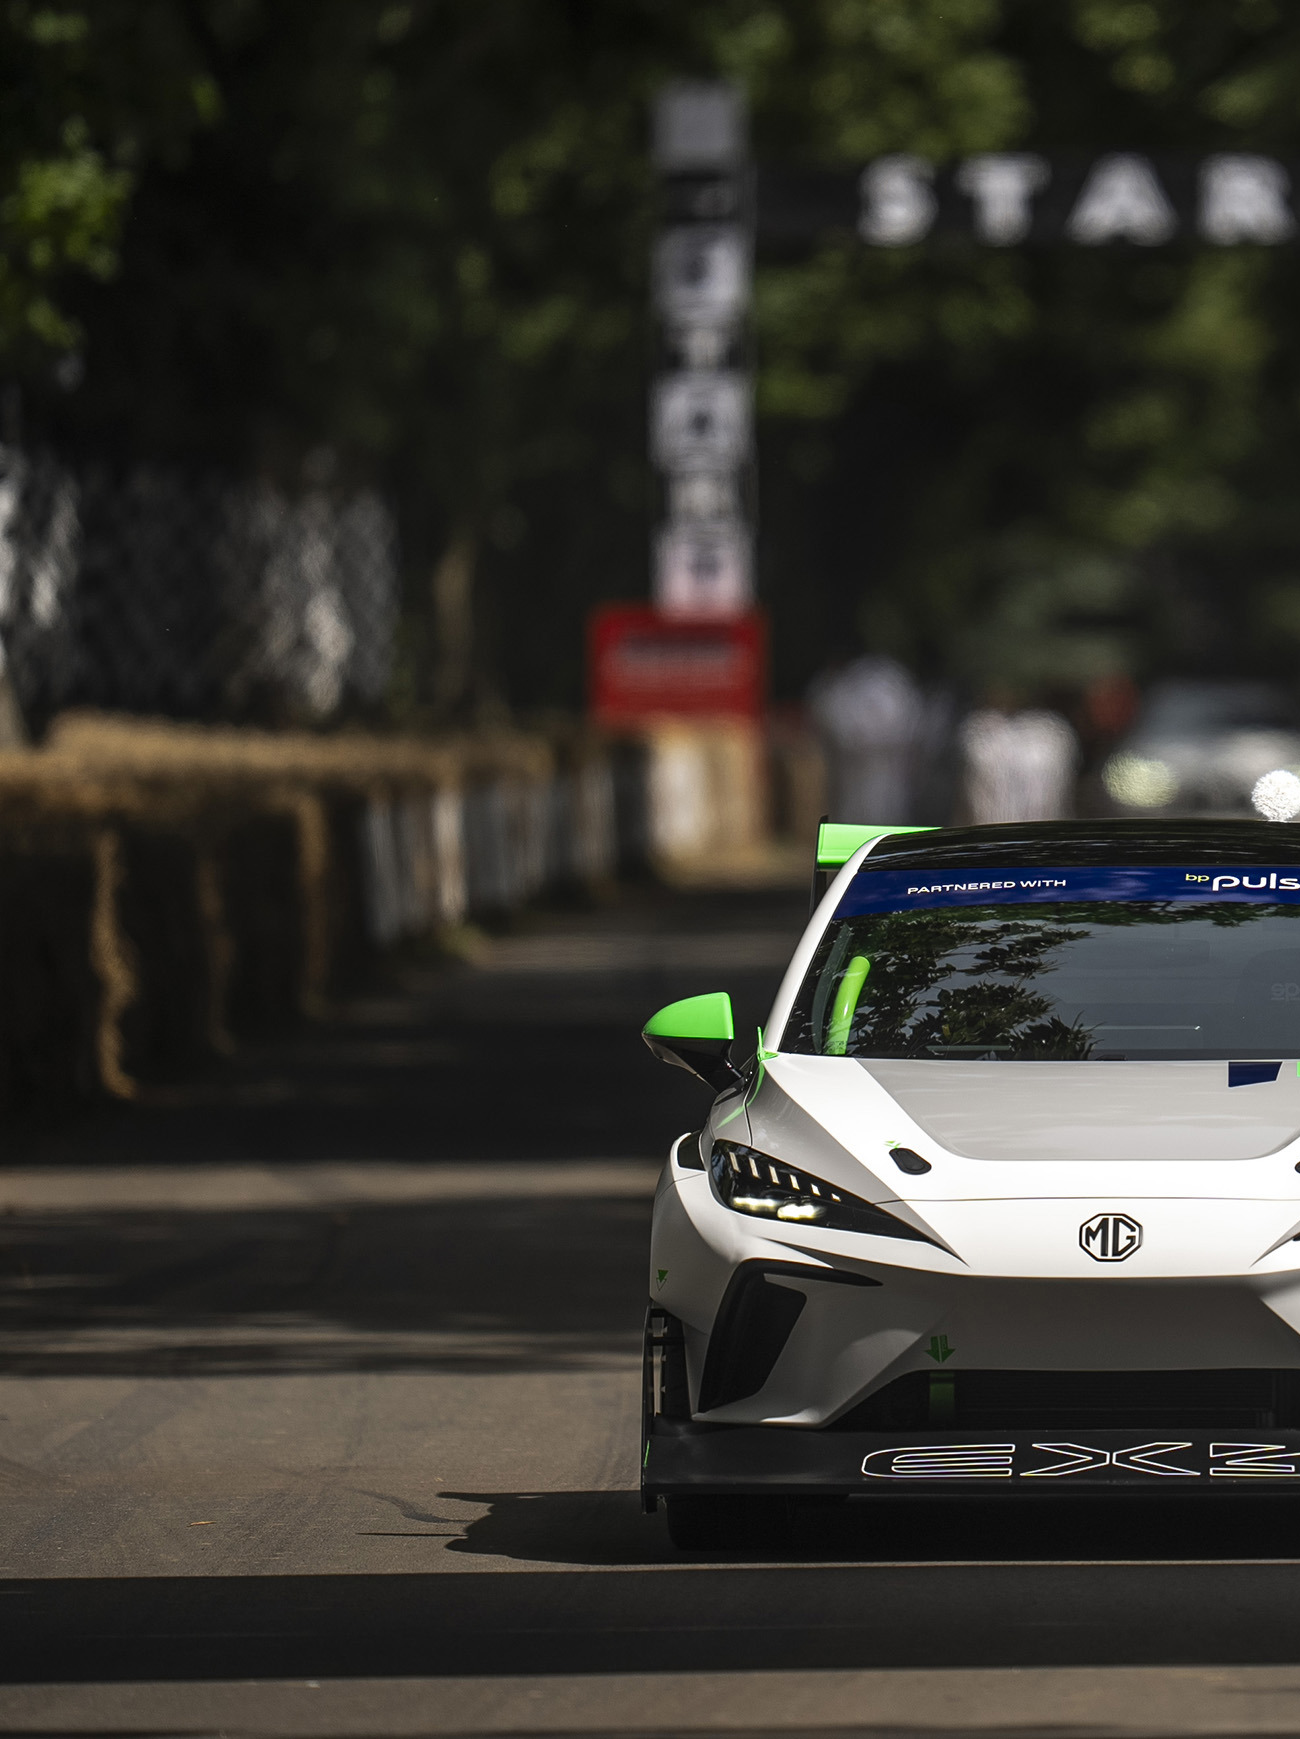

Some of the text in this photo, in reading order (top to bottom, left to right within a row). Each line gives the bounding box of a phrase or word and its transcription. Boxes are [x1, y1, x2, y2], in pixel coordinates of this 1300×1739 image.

[1185, 873, 1210, 883] bp
[907, 879, 1067, 895] PARTNERED WITH
[1085, 1217, 1136, 1257] MG
